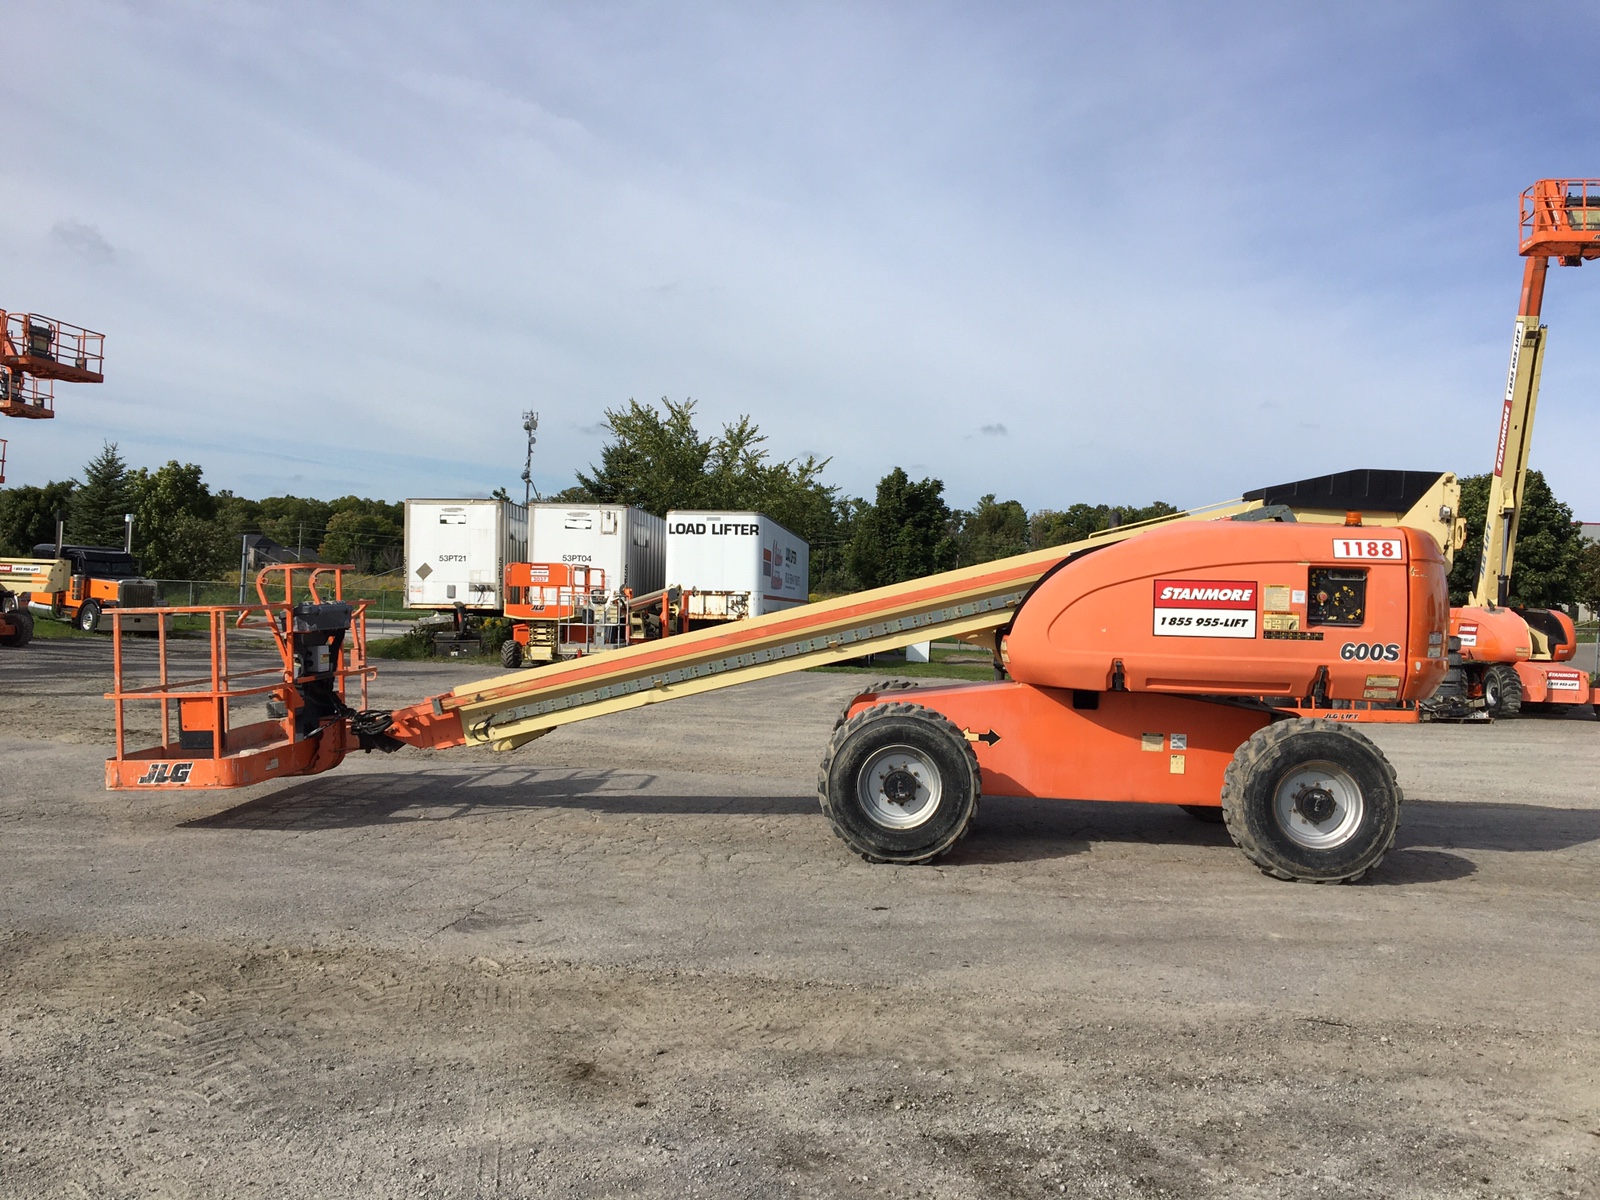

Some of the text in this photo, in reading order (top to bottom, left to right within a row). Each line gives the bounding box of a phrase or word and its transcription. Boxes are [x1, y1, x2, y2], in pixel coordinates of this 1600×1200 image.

[1497, 405, 1510, 471] STANMORE
[668, 523, 760, 536] LOAD LIFTER
[1342, 542, 1394, 557] 1188
[1160, 586, 1252, 601] STANMORE
[1161, 617, 1248, 628] 1 855 955-LIFT
[1340, 642, 1400, 662] 600S
[138, 762, 194, 784] JLG
